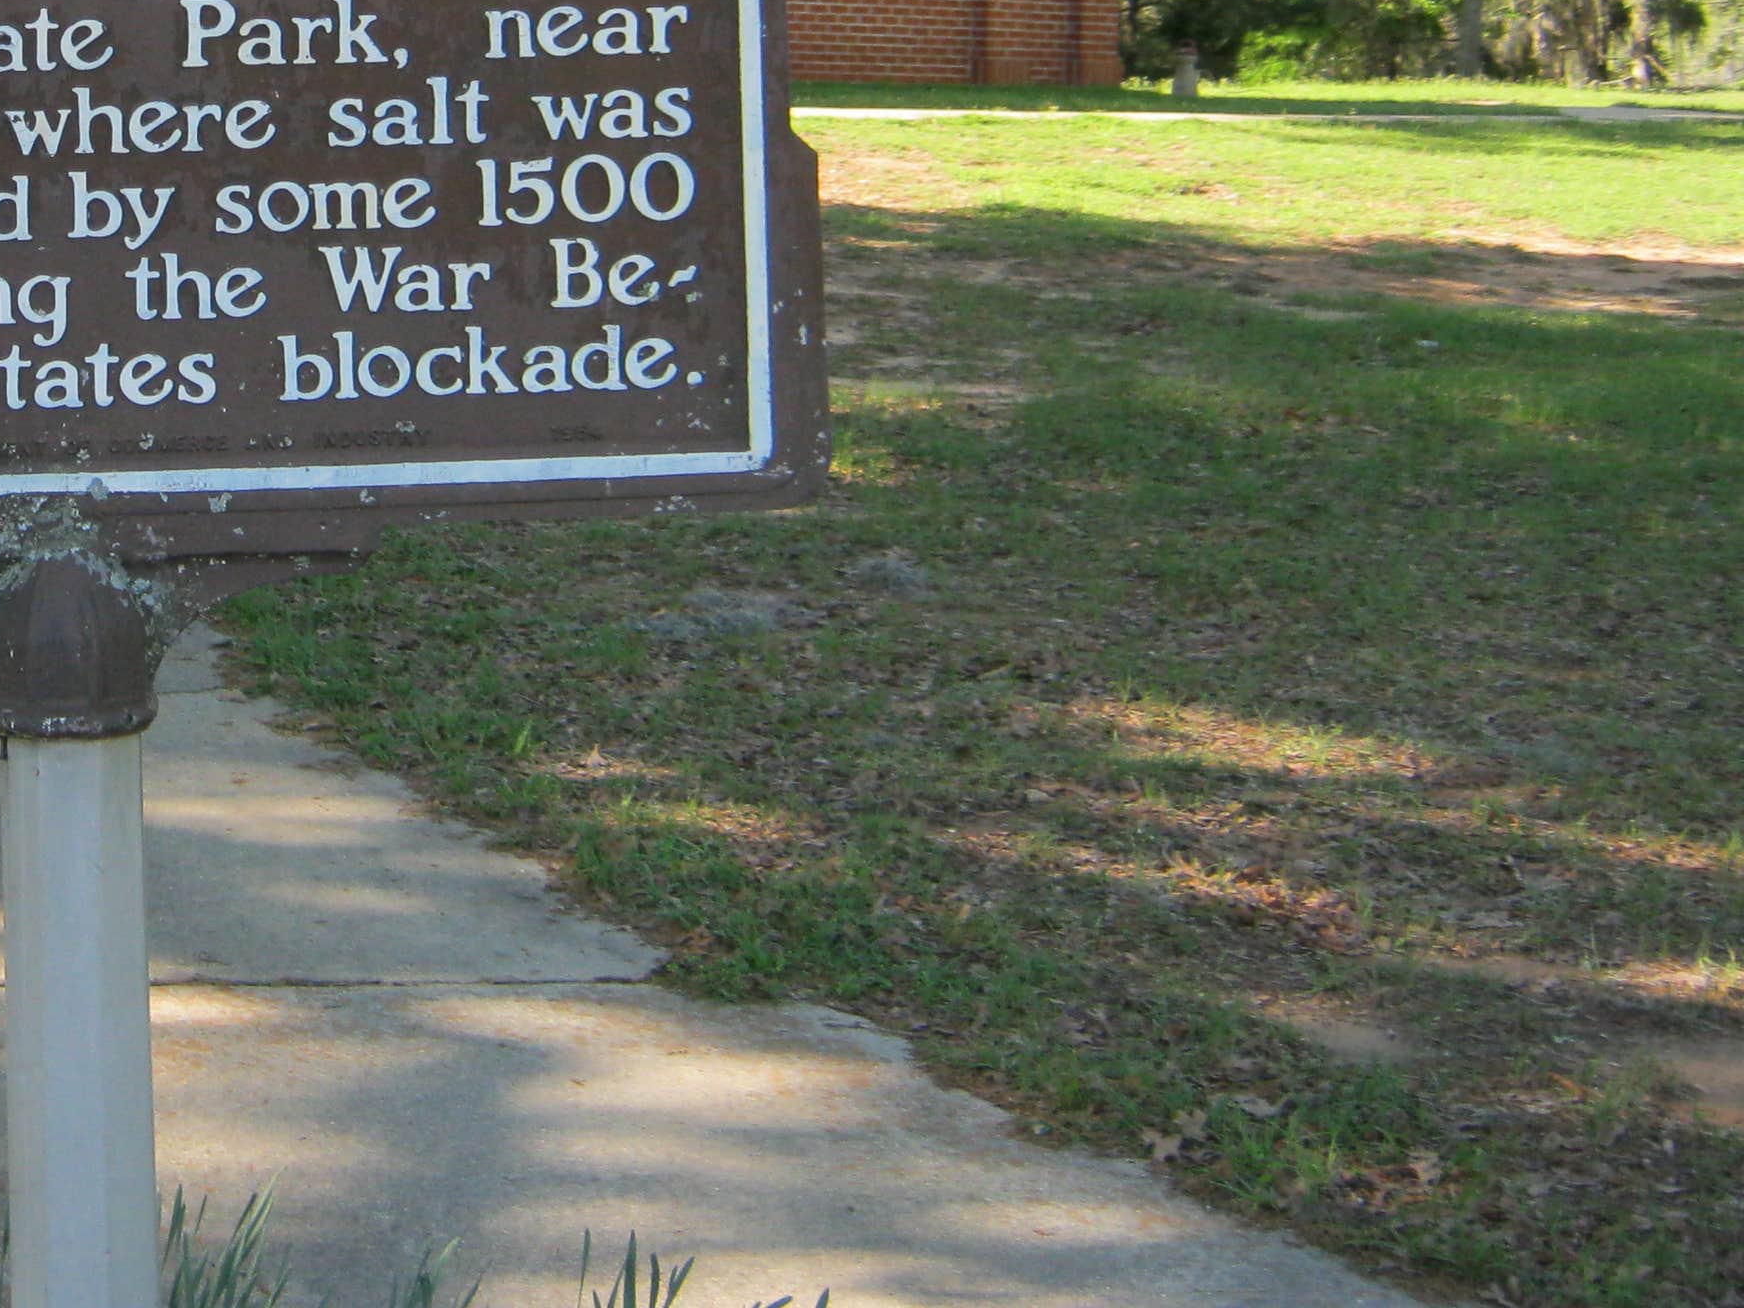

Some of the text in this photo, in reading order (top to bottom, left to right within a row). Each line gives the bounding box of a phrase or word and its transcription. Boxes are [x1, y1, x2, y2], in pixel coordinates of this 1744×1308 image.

[483, 4, 689, 60] near
[3, 85, 277, 159] where
[326, 75, 491, 148] salt
[529, 86, 693, 142] was
[66, 170, 177, 251] by
[214, 176, 437, 235] some
[474, 151, 696, 228] 1500
[123, 251, 268, 321] the
[316, 244, 492, 314] War
[548, 236, 698, 309] Be-
[275, 323, 704, 402] blockade.
